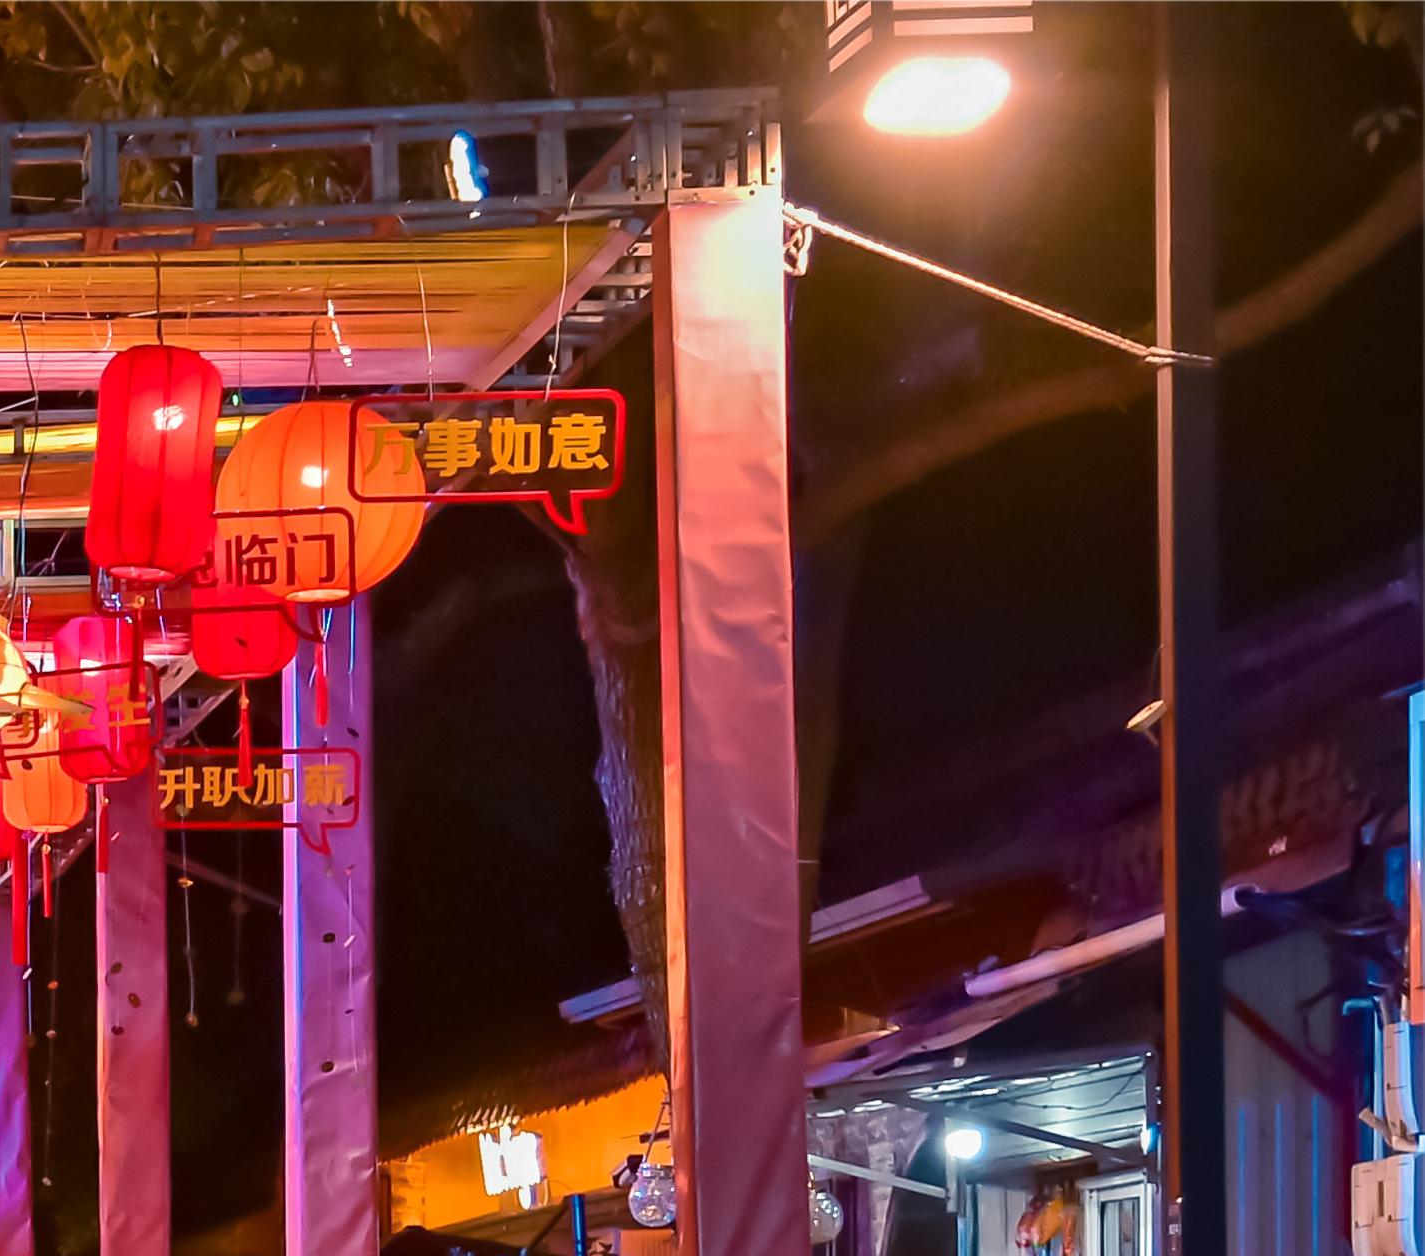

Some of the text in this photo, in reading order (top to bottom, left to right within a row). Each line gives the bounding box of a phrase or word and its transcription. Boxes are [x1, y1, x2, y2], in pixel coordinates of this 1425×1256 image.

[363, 413, 610, 477] 万事如意
[157, 763, 347, 810] 升职加薪
